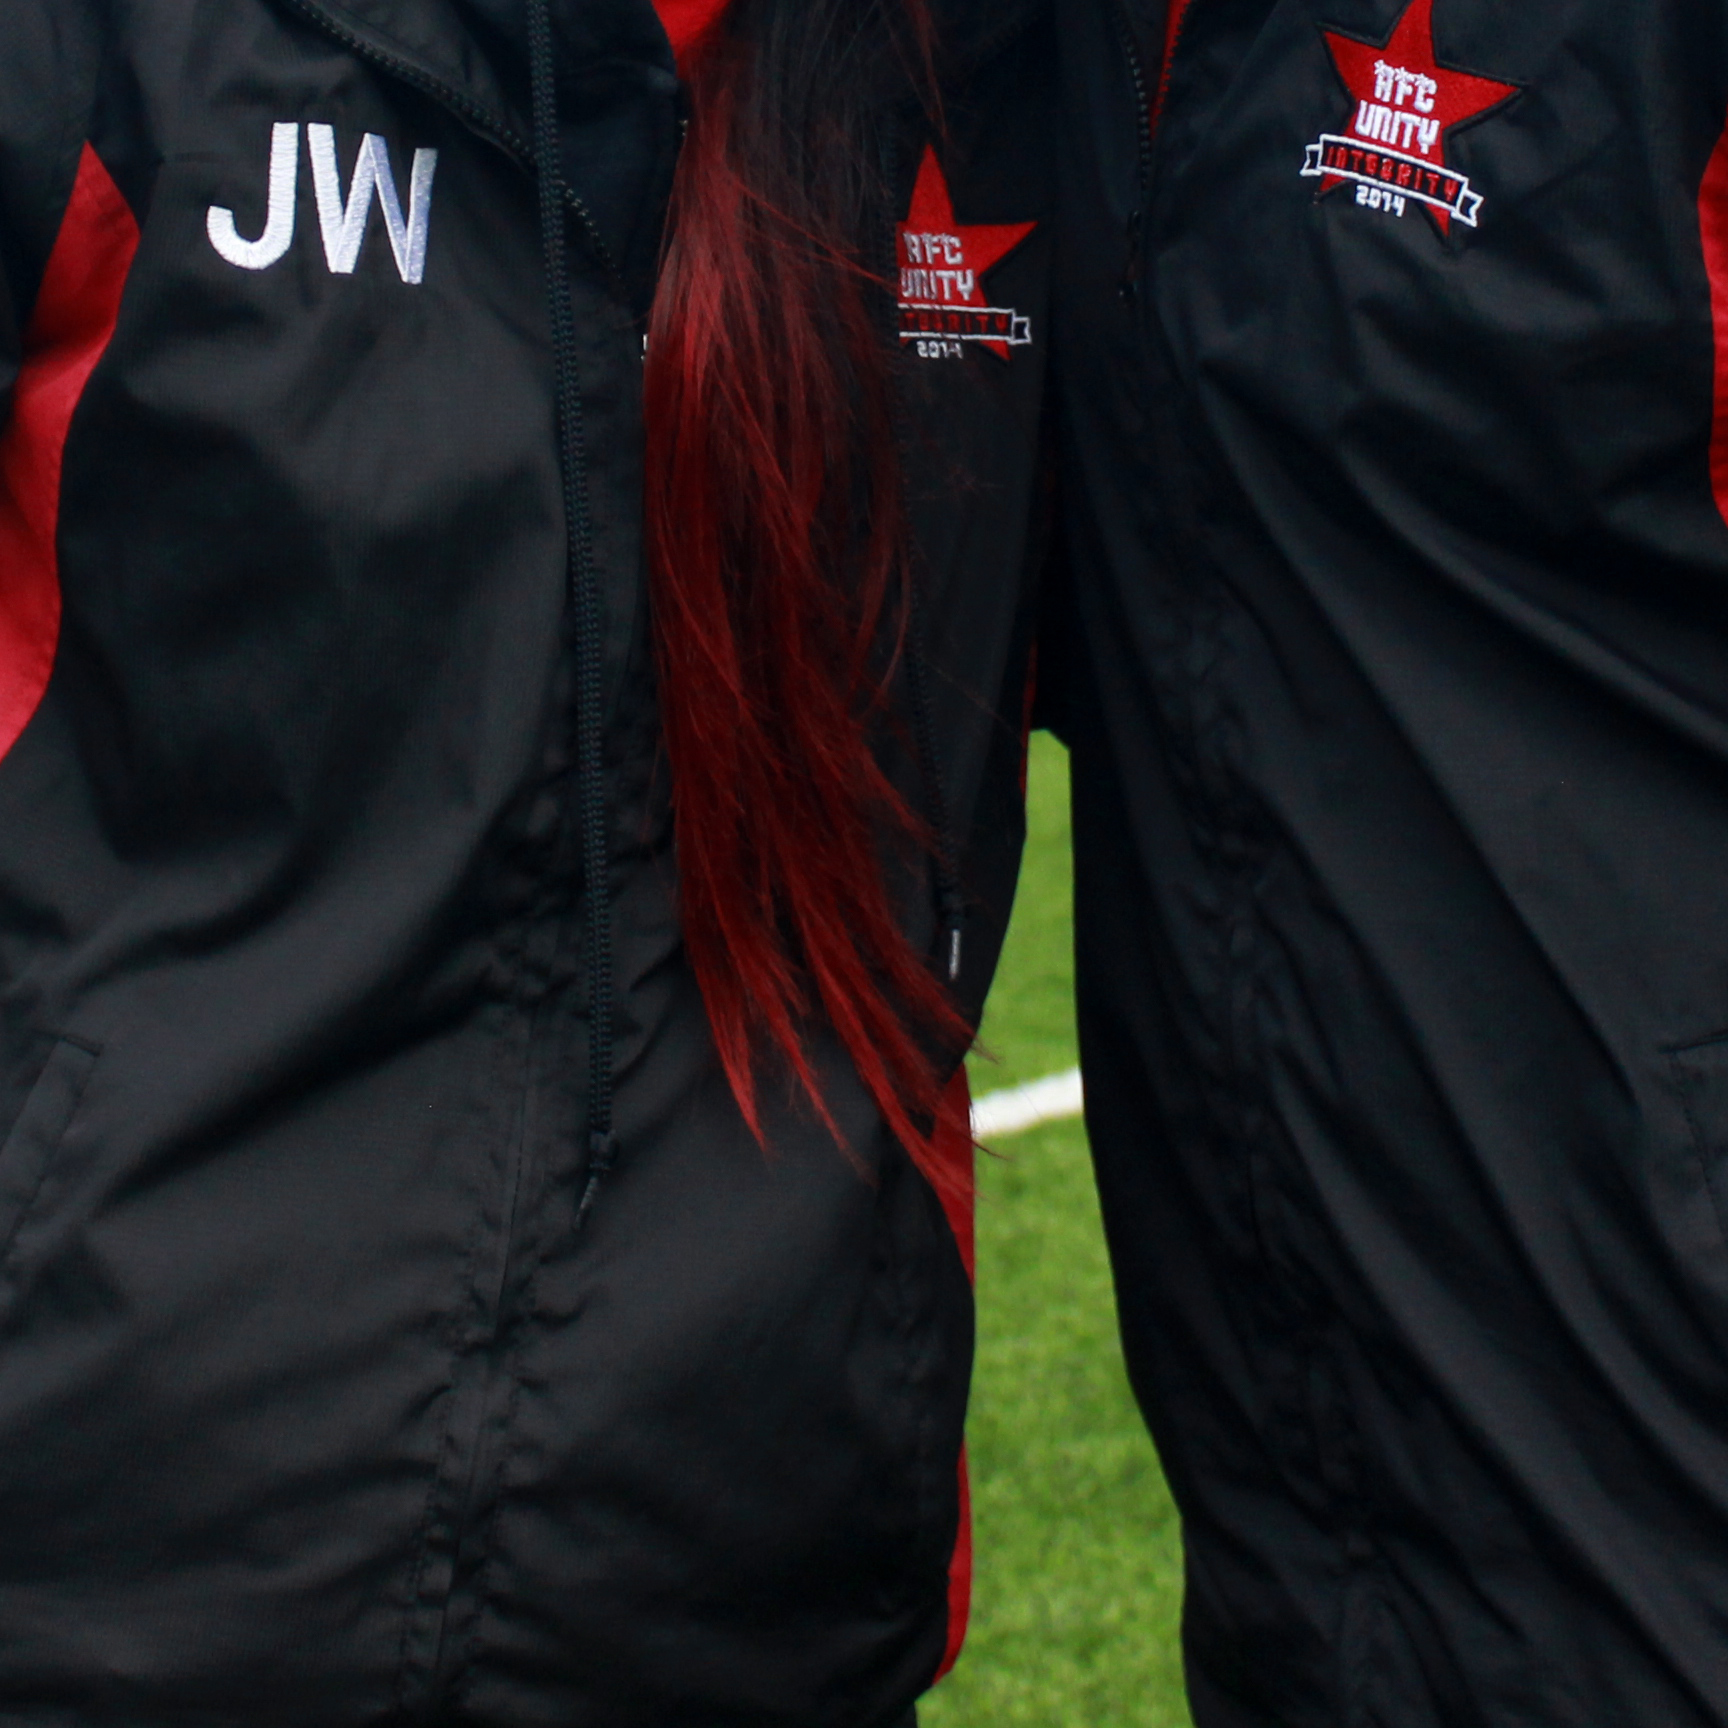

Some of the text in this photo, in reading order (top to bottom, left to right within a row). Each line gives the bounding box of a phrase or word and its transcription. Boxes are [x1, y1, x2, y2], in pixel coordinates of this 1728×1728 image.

[1374, 59, 1436, 111] AFC
[1354, 99, 1438, 152] UNITY
[1325, 146, 1457, 200] INTEGRITY
[206, 121, 439, 285] JW
[1355, 184, 1405, 216] 2014
[900, 267, 973, 300] UNITY
[916, 340, 962, 358] 2014
